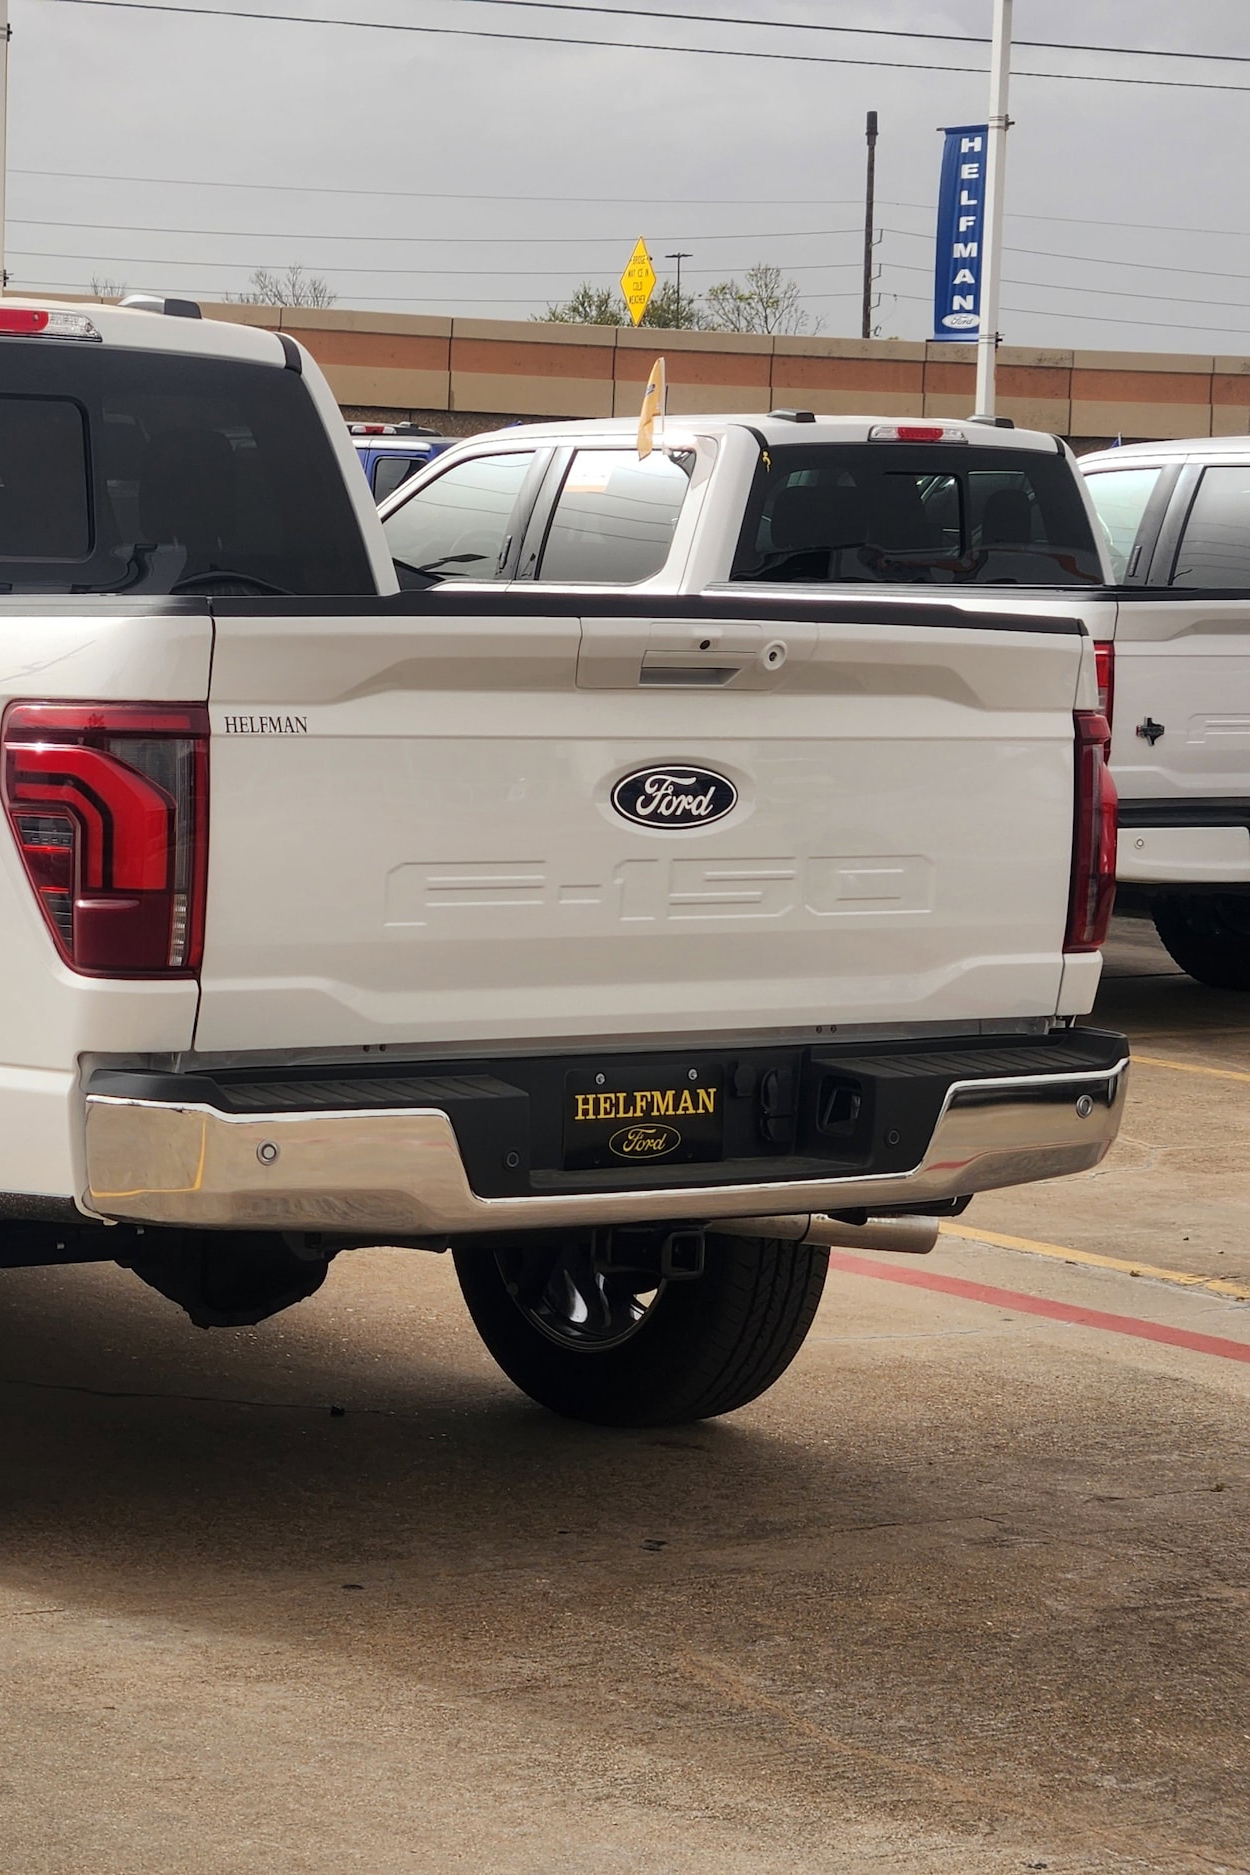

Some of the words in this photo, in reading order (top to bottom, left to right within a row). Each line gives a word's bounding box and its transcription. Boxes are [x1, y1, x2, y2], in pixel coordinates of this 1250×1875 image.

[952, 136, 983, 311] HELFMAN
[224, 716, 308, 733] HELFMAN
[635, 774, 717, 817] Ford
[574, 1088, 717, 1121] HELFMAN
[622, 1127, 668, 1153] Ford
